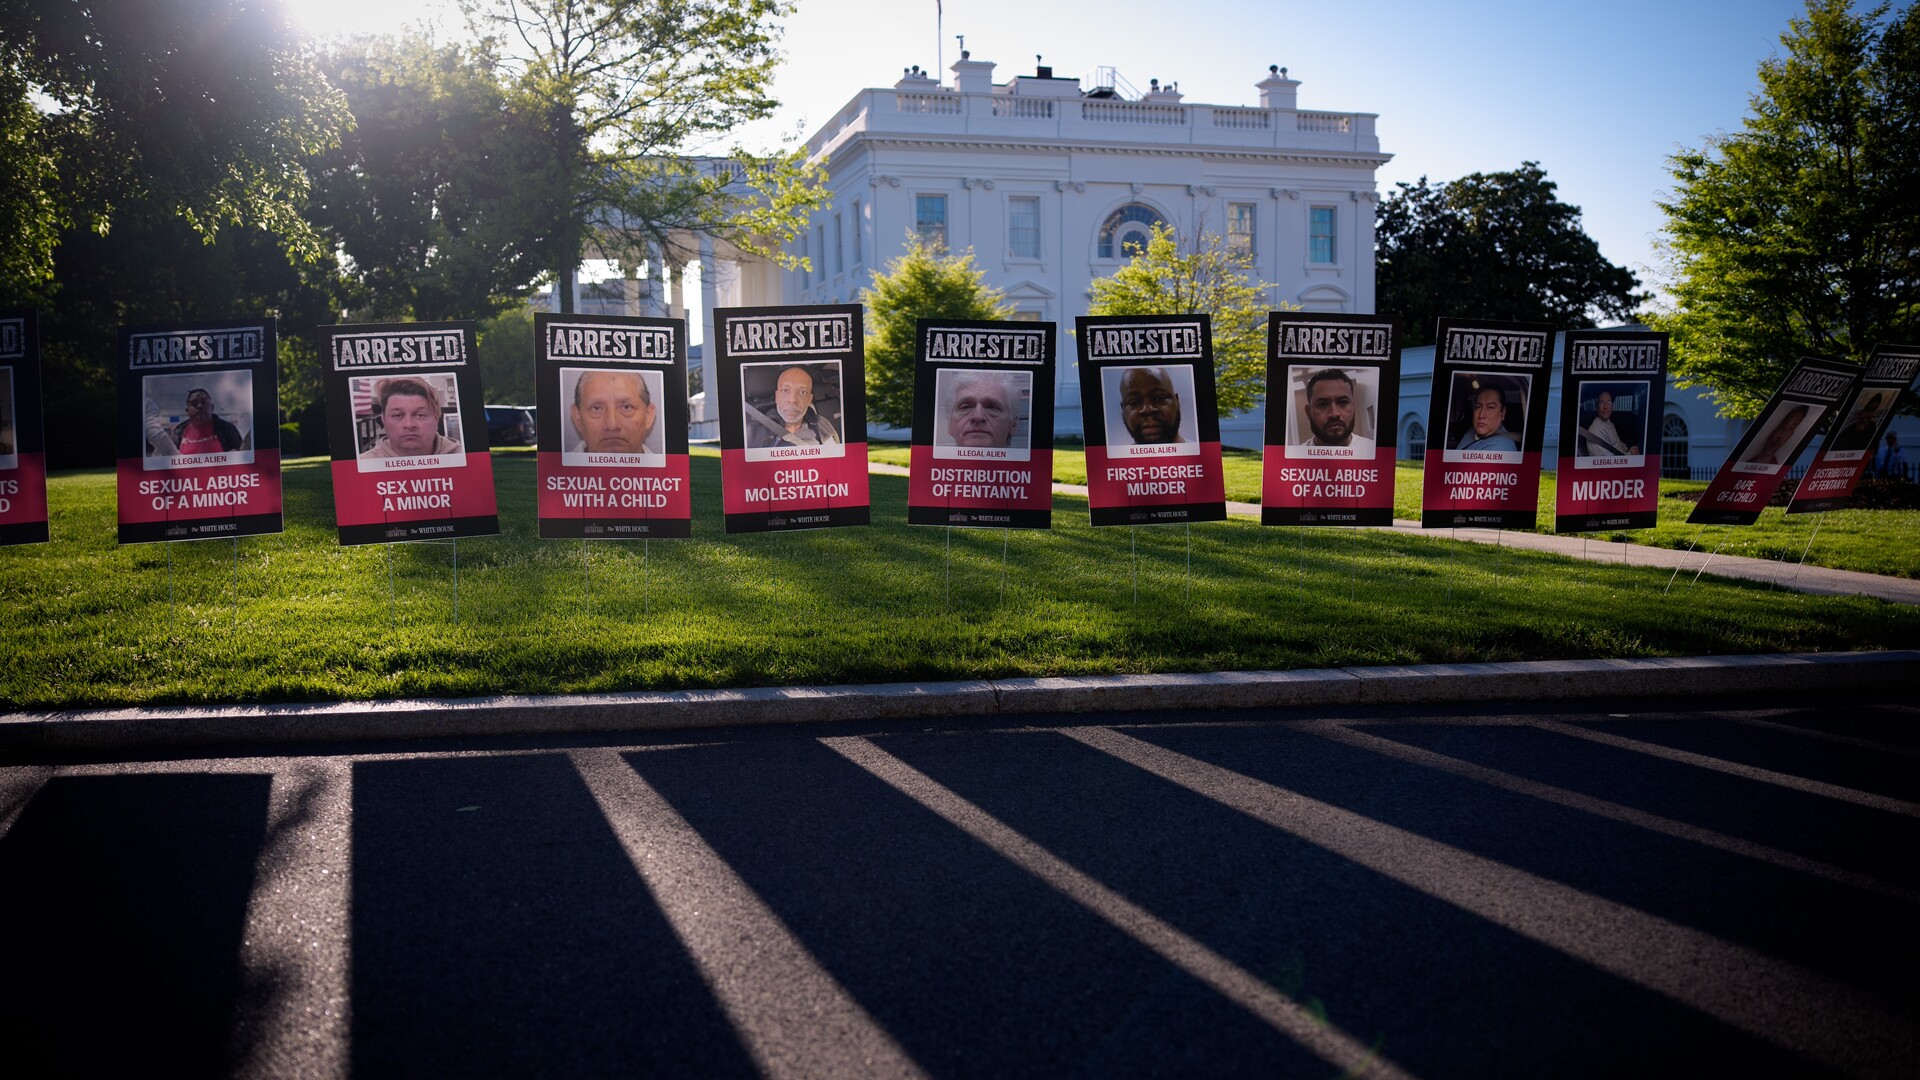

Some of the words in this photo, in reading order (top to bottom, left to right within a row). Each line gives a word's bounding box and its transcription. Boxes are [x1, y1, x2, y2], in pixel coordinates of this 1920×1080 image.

[733, 320, 847, 350] ARRESTED
[1094, 328, 1196, 355] ARRESTED
[1283, 327, 1386, 355] ARRESTED
[136, 332, 258, 364] ARRESTED
[340, 335, 459, 365] ARRESTED
[553, 329, 668, 358] ARRESTED
[931, 333, 1040, 360] ARRESTED
[1449, 333, 1541, 362] ARRESTED
[1575, 345, 1658, 370] ARRESTED
[1867, 357, 1919, 379] ARRESTED
[1788, 371, 1852, 396] ARRESTED
[770, 449, 799, 458] ILLEGAL
[800, 448, 821, 457] ALIEN
[957, 449, 985, 458] ILLEGAL
[986, 450, 1006, 458] ALIEN
[1130, 447, 1157, 455] ILLEGAL
[1157, 446, 1177, 454] ALIEN
[1307, 448, 1333, 457] ILLEGAL
[1334, 449, 1353, 457] ALIEN
[1462, 452, 1485, 460] ILLEGAL
[171, 456, 203, 466] ILLEGAL
[204, 455, 227, 464] ALIEN
[385, 458, 416, 468] ILLEGAL
[417, 457, 440, 466] ALIEN
[588, 455, 618, 464] ILLEGAL
[619, 456, 641, 464] ALIEN
[1592, 458, 1612, 466] ILLEGAL
[1613, 457, 1628, 465] ALIEN
[773, 468, 819, 484] CHILD
[930, 468, 1031, 484] DISTRIBUTION
[1106, 464, 1204, 481] FIRST-DEGREE
[1280, 468, 1332, 483] SEXUAL
[1334, 468, 1378, 483] ABUSE
[1443, 471, 1518, 486] KIDNAPPING
[1812, 466, 1858, 479] DISTRIBUTION
[139, 477, 206, 495] SEXUAL
[206, 473, 260, 490] ABUSE
[376, 480, 409, 496] SEX
[409, 477, 454, 494] WITH
[546, 476, 607, 492] SEXUAL
[609, 476, 682, 492] CONTACT
[1127, 481, 1186, 496] MURDER
[1292, 484, 1310, 498] OF
[1312, 484, 1323, 497] A
[1325, 484, 1365, 498] CHILD
[1571, 479, 1645, 501] MURDER
[1733, 479, 1757, 491] RAPE
[1808, 480, 1820, 492] OF
[1816, 479, 1849, 491] FENTANYL
[745, 483, 849, 502] MOLESTATION
[932, 484, 952, 497] OF
[954, 484, 1028, 500] FENTANYL
[1449, 486, 1474, 500] AND
[1475, 487, 1509, 501] RAPE
[1716, 491, 1731, 502] OF
[1726, 491, 1736, 502] A
[1733, 491, 1757, 503] CHILD
[152, 496, 175, 511] OF
[177, 495, 190, 509] A
[192, 491, 248, 508] MINOR
[382, 497, 395, 512] A
[397, 494, 452, 511] MINOR
[562, 493, 604, 508] WITH
[607, 493, 619, 508] A
[620, 493, 667, 508] CHILD
[978, 514, 994, 522] WHITE
[994, 515, 1011, 523] HOUSE
[1341, 514, 1357, 522] HOUSE
[199, 524, 217, 533] WHITE
[218, 523, 237, 532] HOUSE
[437, 525, 455, 533] HOUSE
[614, 525, 632, 533] WHITE
[632, 525, 649, 533] HOUSE
